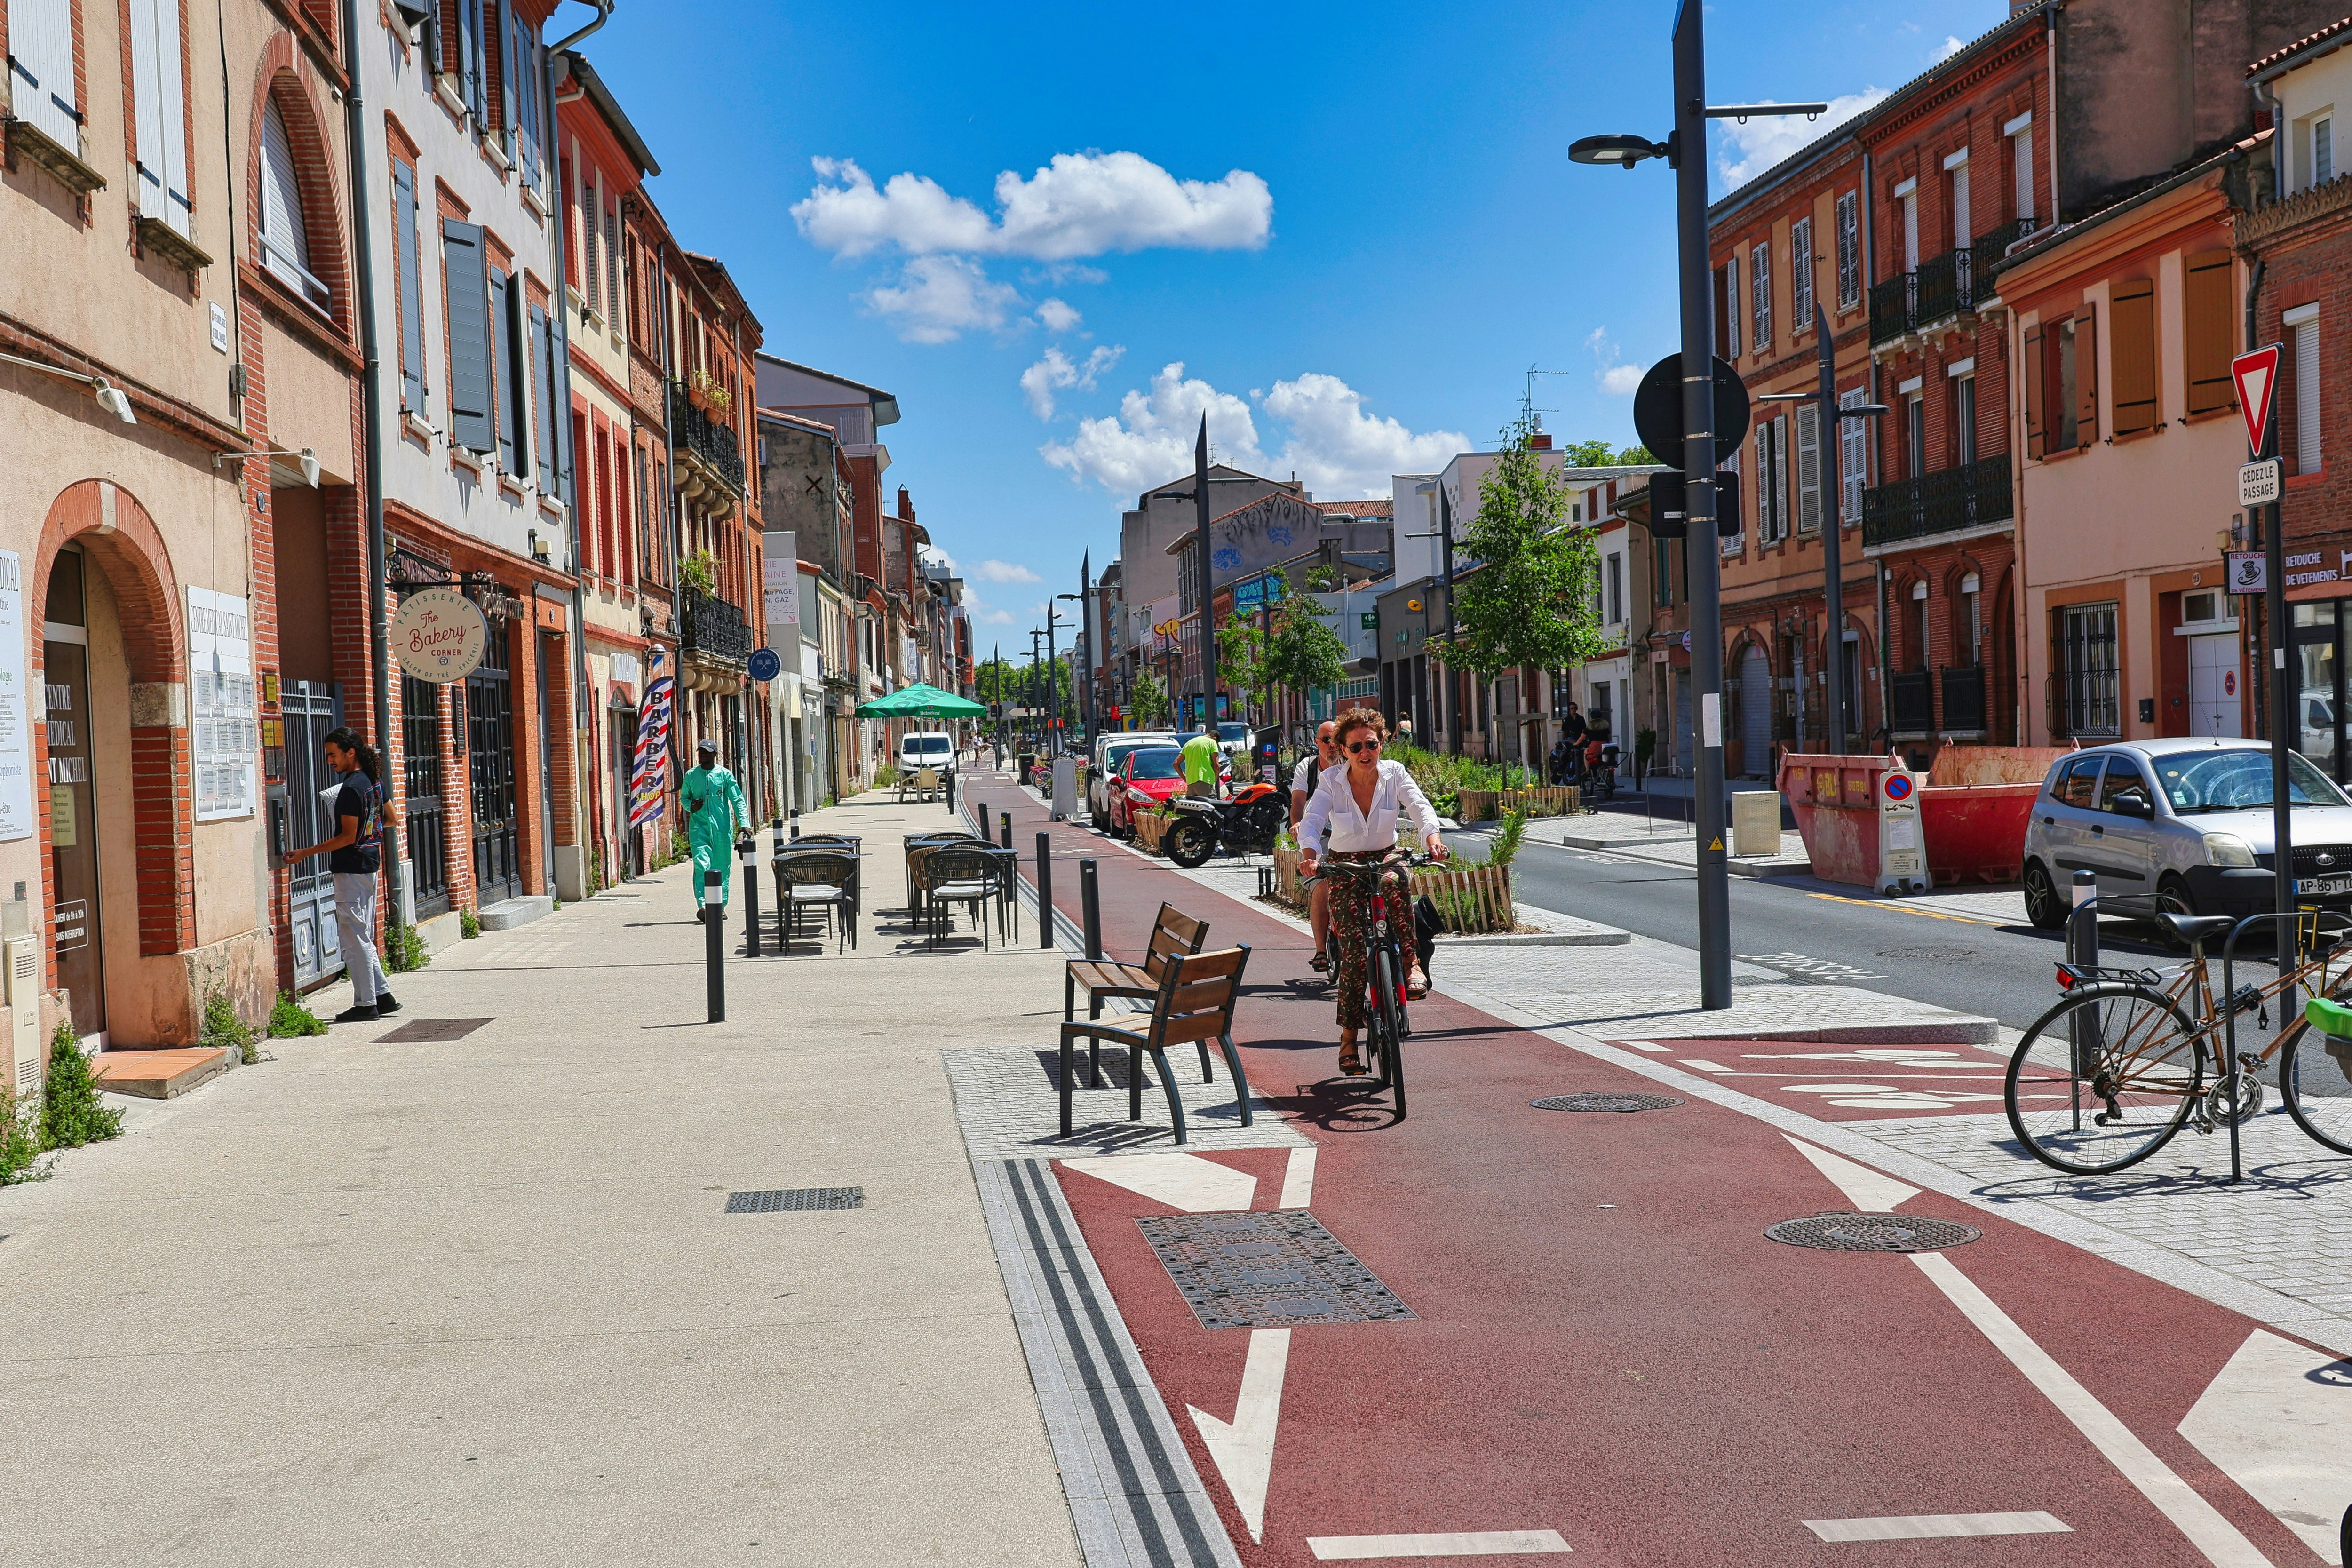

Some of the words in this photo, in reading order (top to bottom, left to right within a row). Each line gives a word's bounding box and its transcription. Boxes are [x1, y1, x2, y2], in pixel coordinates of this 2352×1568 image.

[2243, 468, 2264, 483] CÉDEZ
[2265, 466, 2273, 478] LE
[2243, 482, 2273, 500] PASSAGE
[2286, 552, 2322, 567] RETOUCHE
[2286, 575, 2296, 586] DE
[2296, 570, 2338, 585] VETEMENTS
[397, 594, 469, 625] PÂTISSERIE
[420, 611, 438, 628] The
[409, 625, 467, 652] Bakery
[403, 657, 421, 674] SALON
[458, 643, 479, 671] ÉPICERIE
[755, 651, 778, 668] HOMECCITANIA
[642, 692, 664, 789] BARBER
[58, 757, 87, 783] MICHEL
[636, 790, 660, 802] SHOP
[56, 931, 64, 942] SANS
